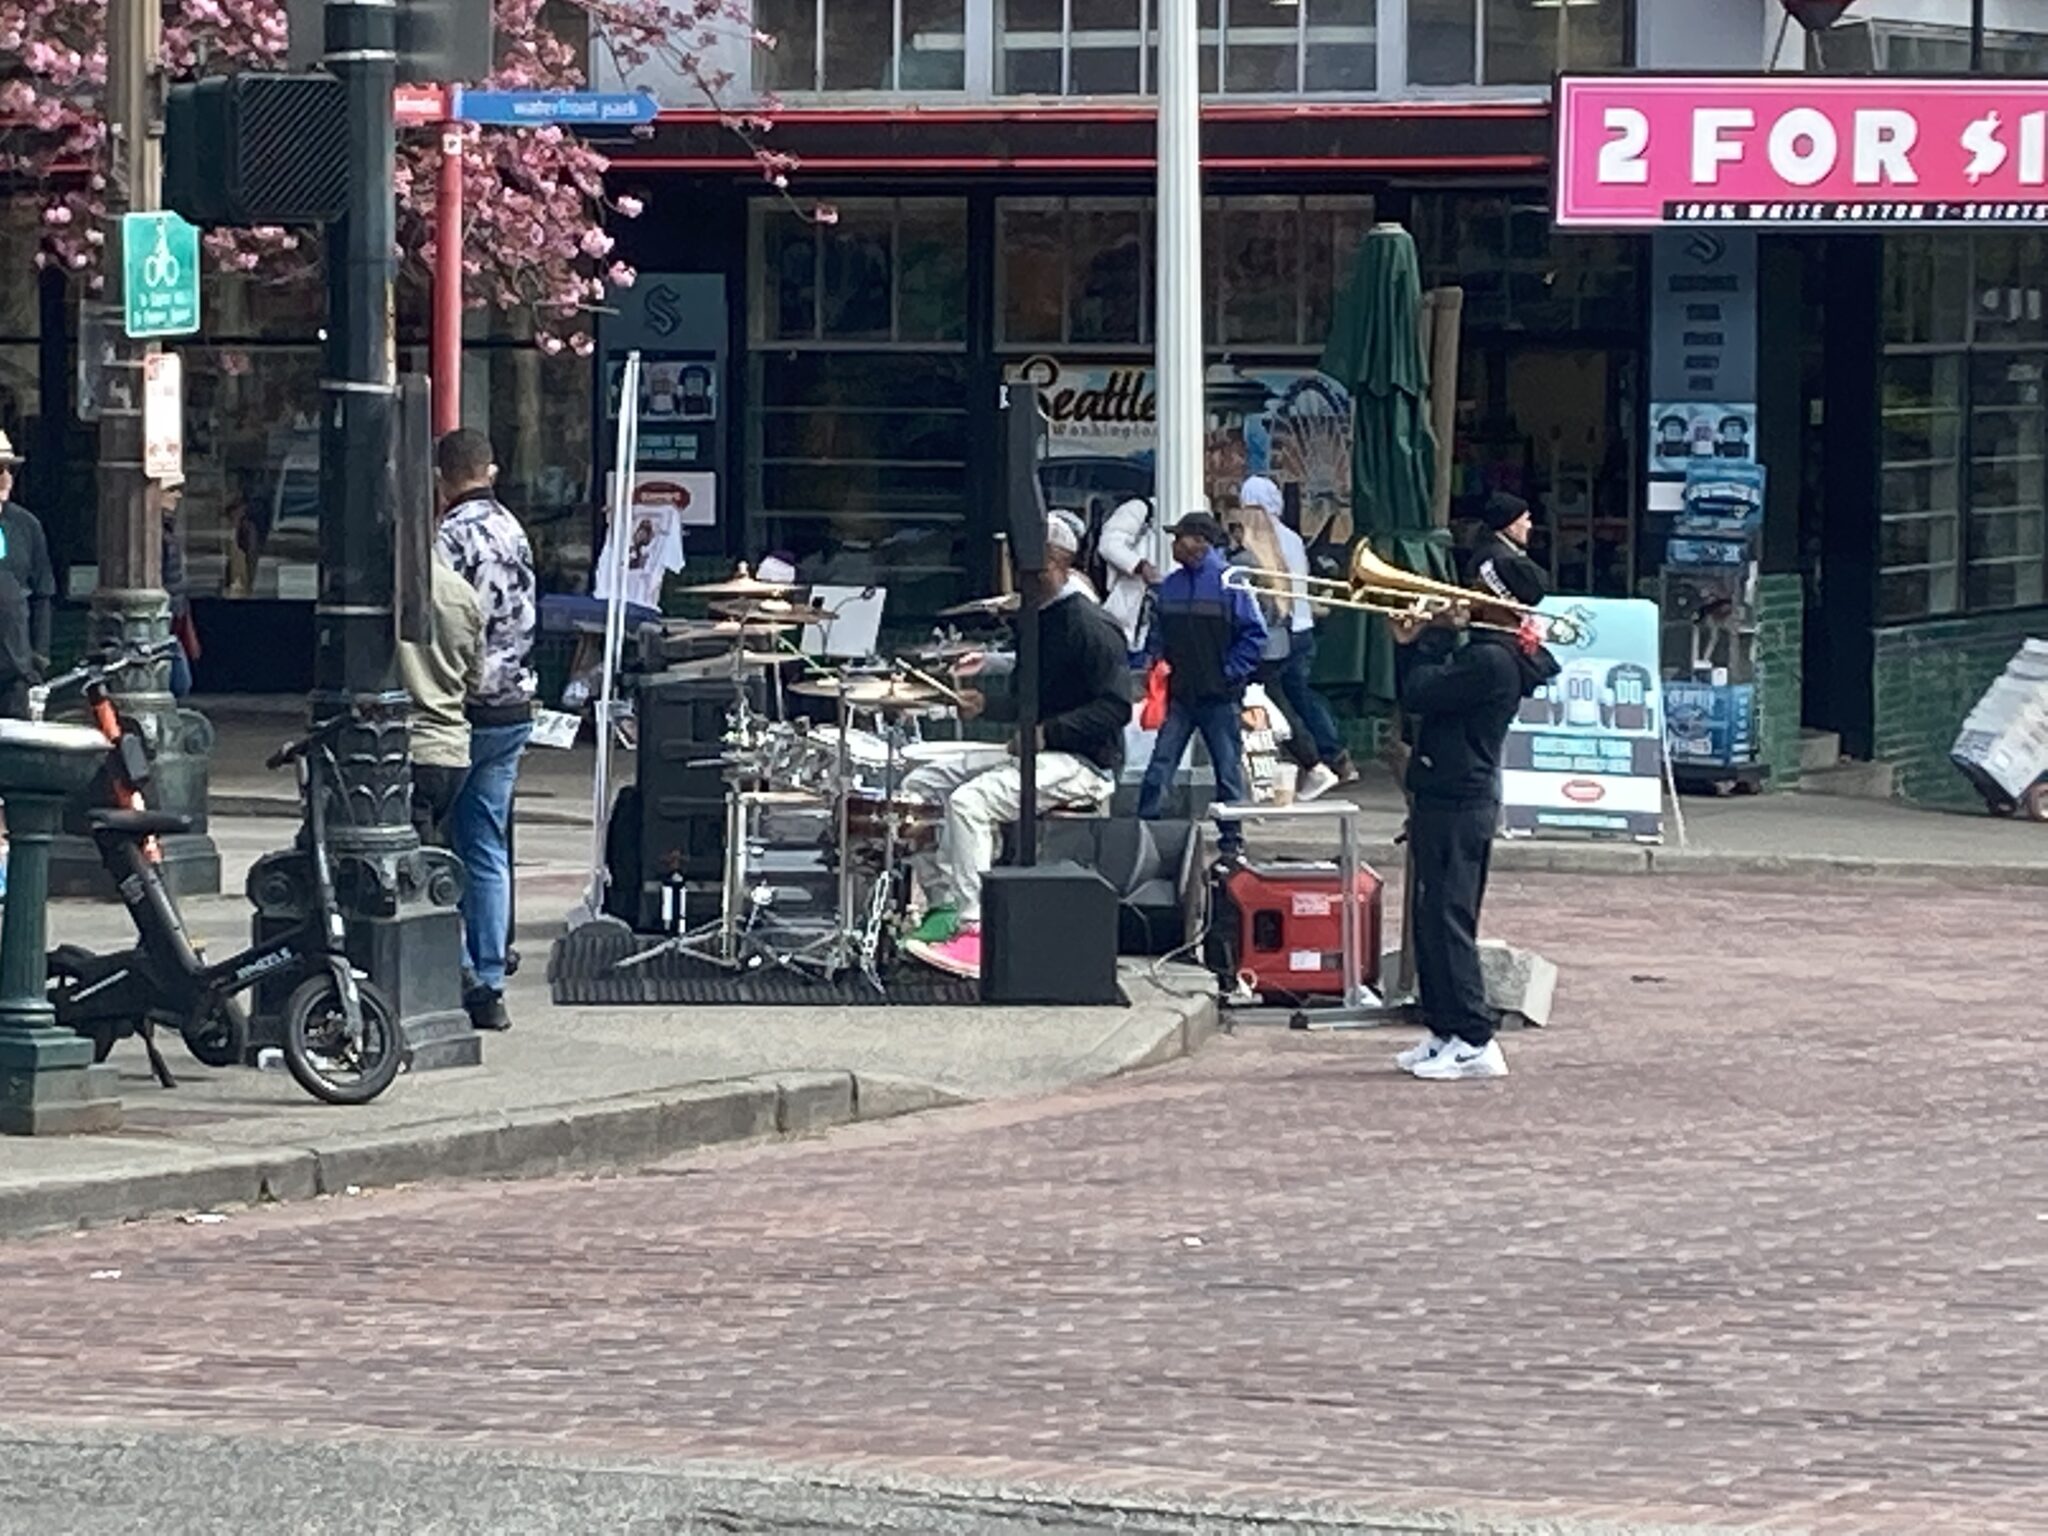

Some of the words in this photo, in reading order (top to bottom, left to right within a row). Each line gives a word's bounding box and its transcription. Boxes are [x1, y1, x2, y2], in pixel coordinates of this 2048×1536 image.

[1597, 107, 1650, 183] 2
[1692, 107, 1919, 186] FOR
[1675, 203, 1736, 219] 100%
[1749, 203, 1824, 219] WHITE
[1834, 203, 1924, 219] COTTON
[1050, 423, 1158, 438] Washingto
